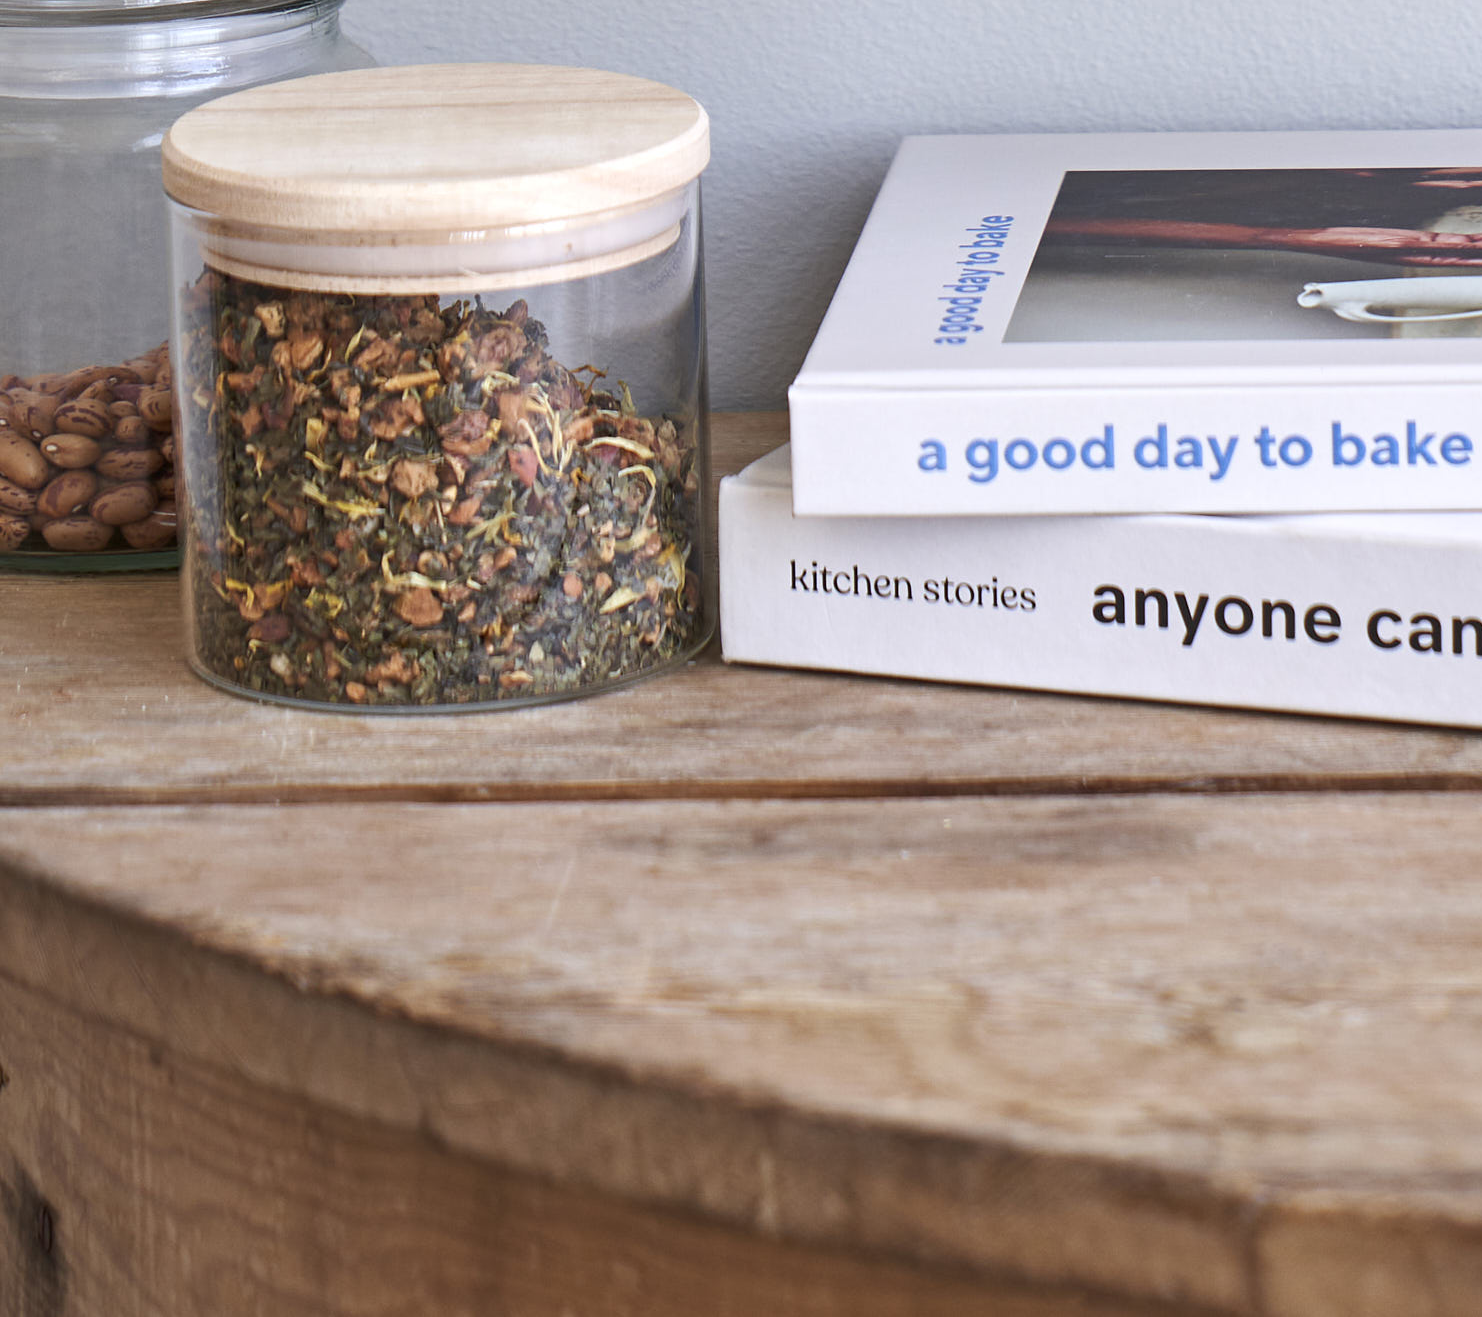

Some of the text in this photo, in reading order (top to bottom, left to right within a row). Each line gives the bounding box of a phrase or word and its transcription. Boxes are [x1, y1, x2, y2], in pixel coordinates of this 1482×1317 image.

[933, 215, 1015, 346] a good day to bake
[917, 420, 1475, 485] a good day to bake
[789, 558, 1038, 612] kitchen stories
[1091, 583, 1343, 648] anyone
